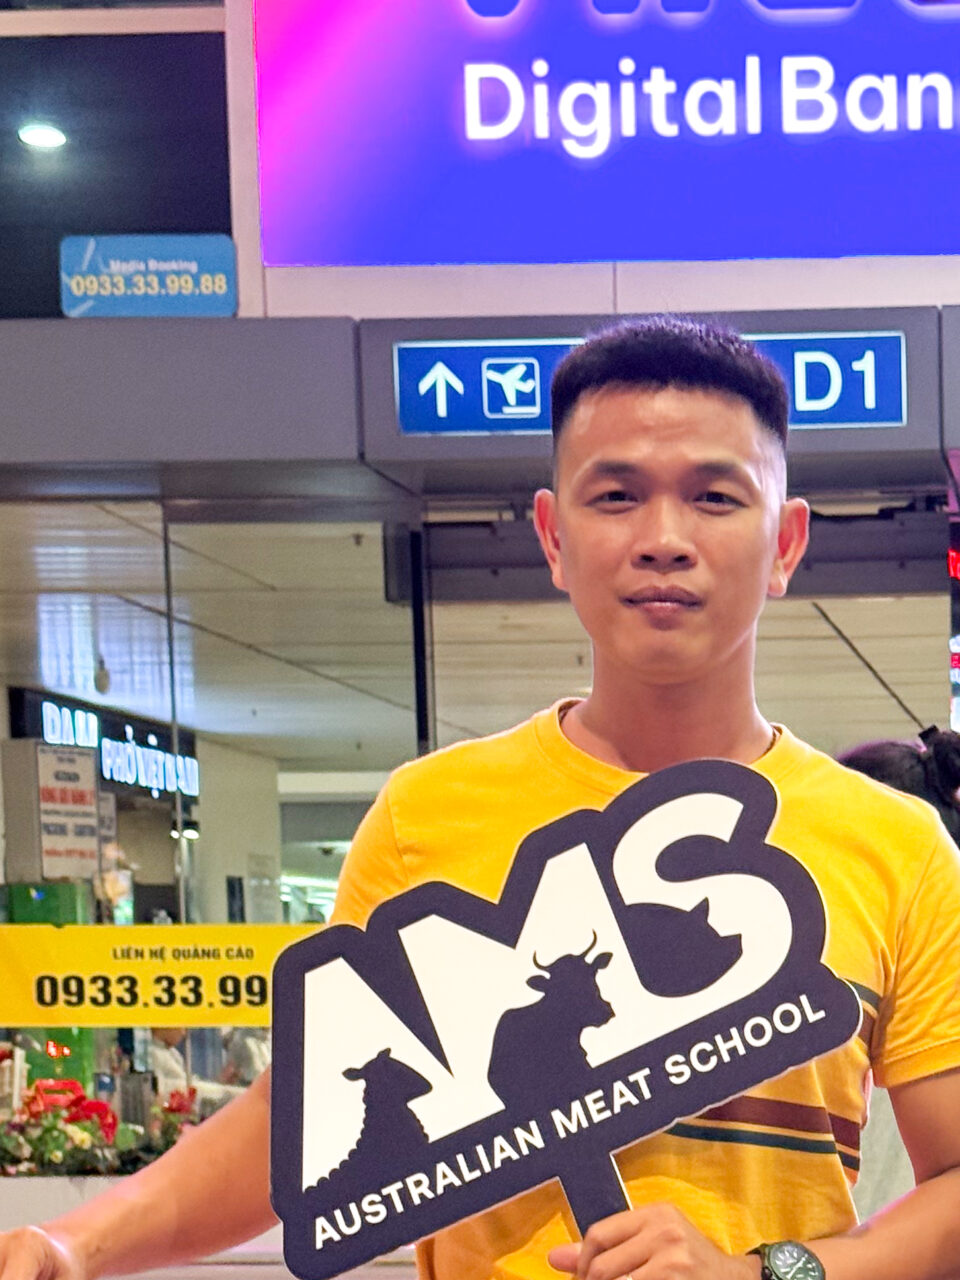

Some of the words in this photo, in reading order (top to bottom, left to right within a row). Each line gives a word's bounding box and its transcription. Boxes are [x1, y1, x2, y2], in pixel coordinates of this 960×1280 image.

[70, 273, 228, 297] 0933.33.99.88
[793, 349, 879, 413] D1
[303, 792, 793, 1193] AMS
[313, 1120, 545, 1250] AUSTRALIAN
[551, 1066, 654, 1136] MEAT
[664, 994, 826, 1087] SCHOOL
